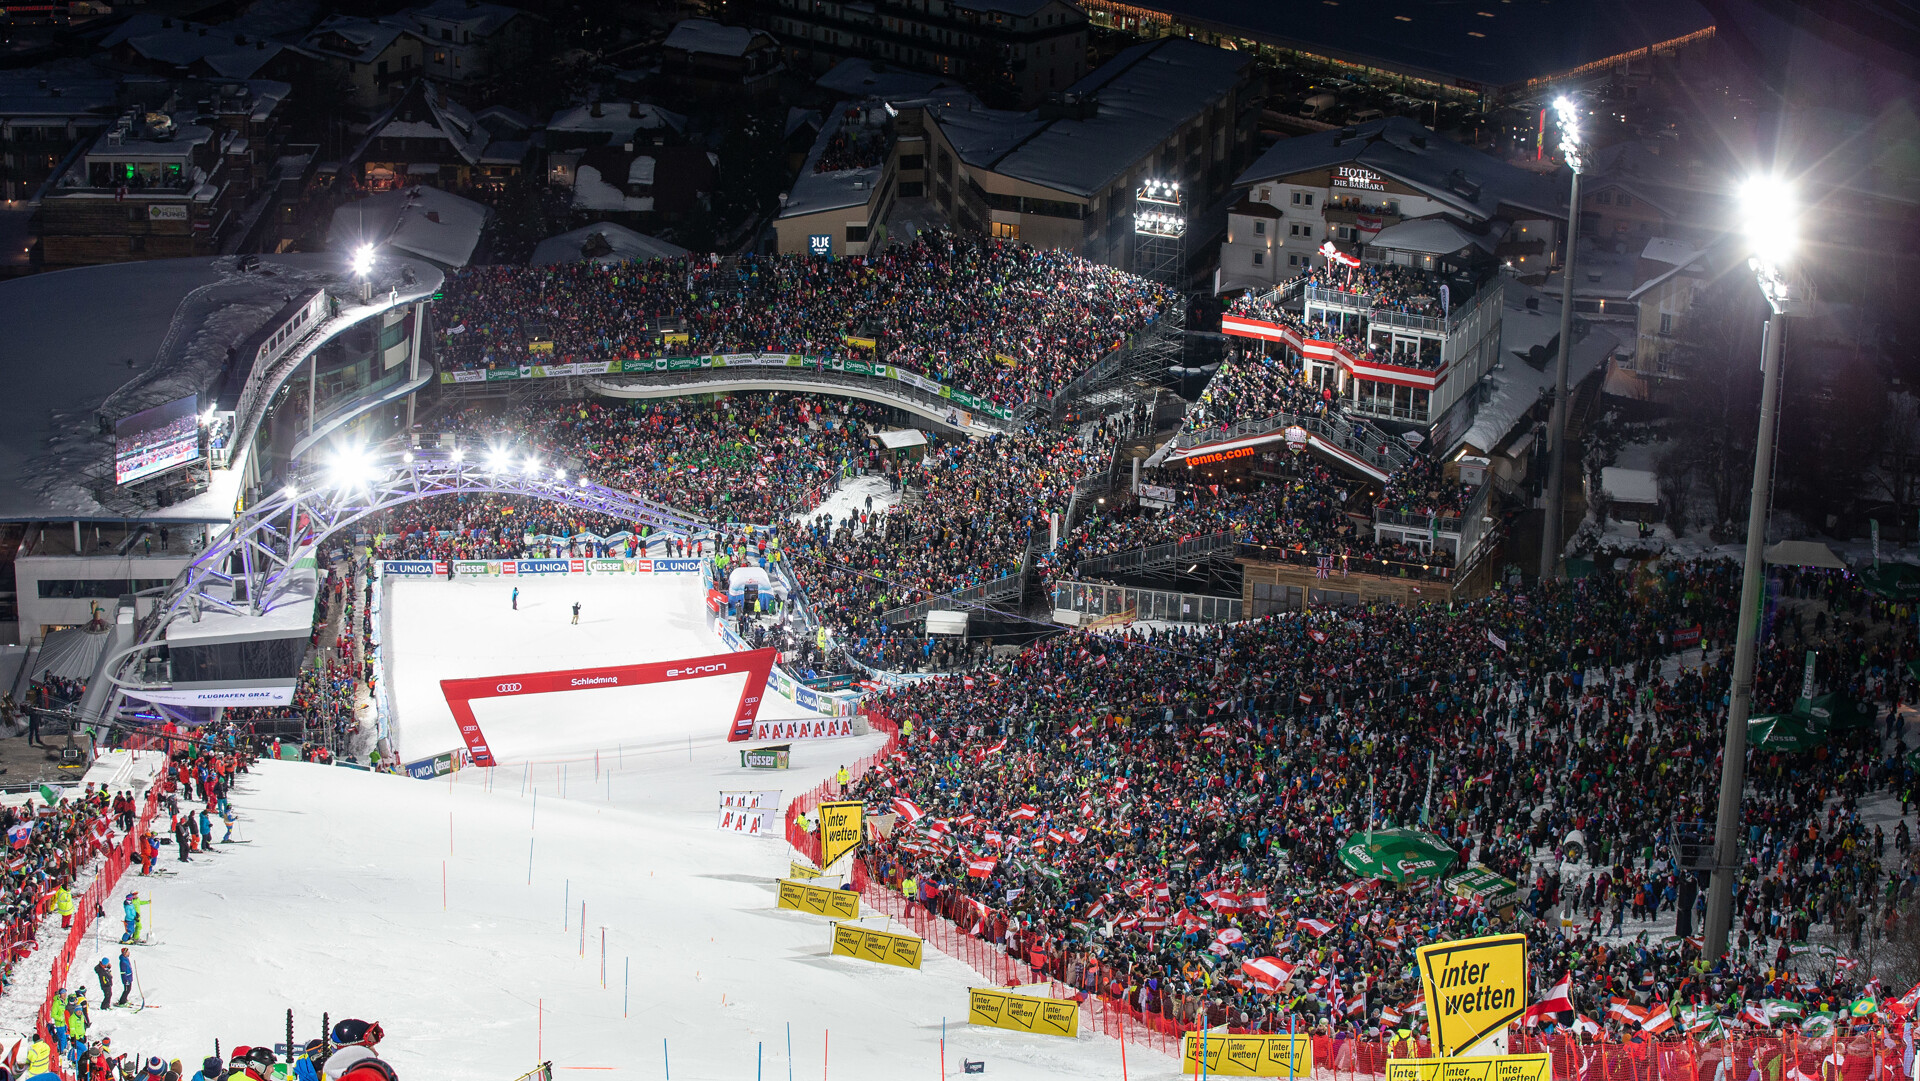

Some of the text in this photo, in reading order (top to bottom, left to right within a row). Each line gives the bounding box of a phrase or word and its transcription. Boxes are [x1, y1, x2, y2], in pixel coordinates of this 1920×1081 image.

[1338, 166, 1380, 180] HOTEL
[1349, 181, 1384, 191] BARBARA
[1186, 446, 1255, 466] tenne.com
[400, 565, 432, 573] UNIQA
[454, 562, 485, 573] Gösser
[535, 563, 568, 571] UNIQA
[588, 561, 621, 572] Gösser
[670, 562, 700, 570] UNIQA
[666, 663, 726, 677] e-tron
[759, 719, 852, 739] A1 A1 A1 A1 A1 A1 A1
[744, 751, 775, 768] Gösser
[414, 764, 433, 778] UNIQA
[434, 758, 451, 774] Gösser
[722, 812, 760, 833] A1 A1 A1
[828, 810, 848, 827] inter
[829, 828, 858, 842] wetten
[1444, 871, 1478, 894] Gösser
[867, 935, 878, 943] inter
[896, 940, 909, 948] inter
[1440, 958, 1490, 988] inter
[1010, 1000, 1023, 1009] inter
[1445, 985, 1515, 1016] wetten
[976, 1003, 999, 1012] wetten
[1011, 1008, 1033, 1017] wetten
[1046, 1005, 1061, 1013] inter
[1047, 1012, 1069, 1021] wetten
[1232, 1051, 1257, 1059] wetten
[1393, 1066, 1419, 1078] inter
[1446, 1066, 1469, 1076] inter
[1499, 1064, 1522, 1074] inter
